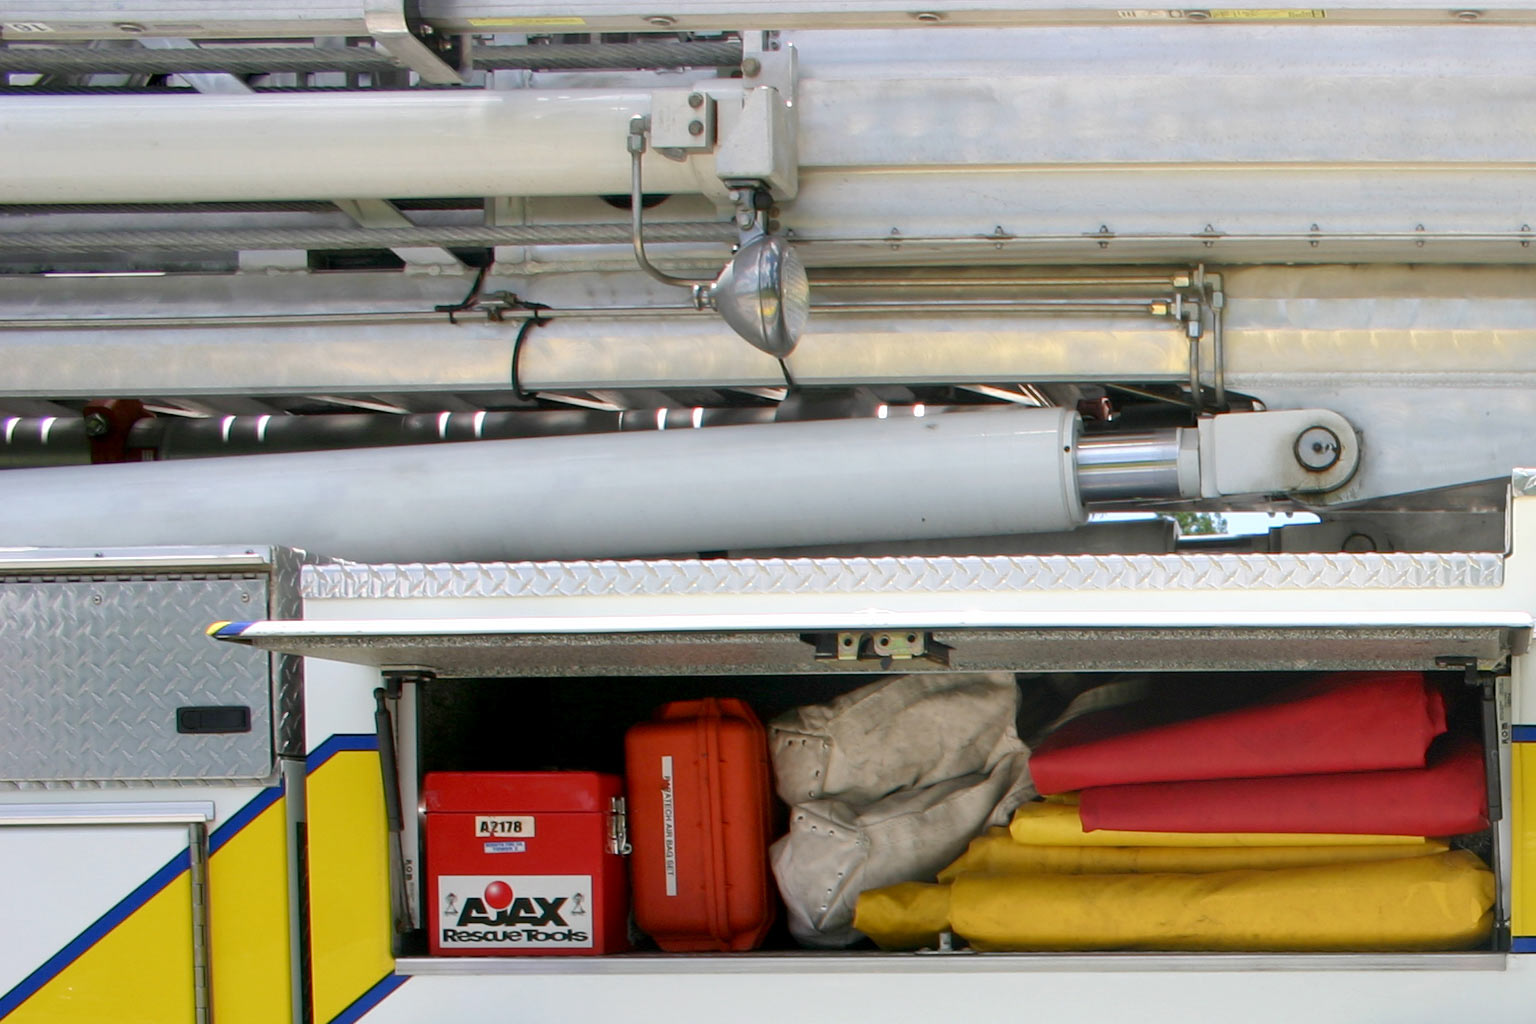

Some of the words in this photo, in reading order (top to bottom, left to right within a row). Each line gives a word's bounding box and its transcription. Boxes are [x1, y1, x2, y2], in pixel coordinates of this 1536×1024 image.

[663, 775, 673, 821] PRATECH
[480, 821, 522, 833] A2178
[665, 823, 673, 838] AIR
[666, 839, 674, 858] BAG
[667, 860, 675, 876] SET
[456, 881, 570, 927] AJAX
[442, 929, 522, 943] Rescue
[522, 929, 589, 943] Tools
